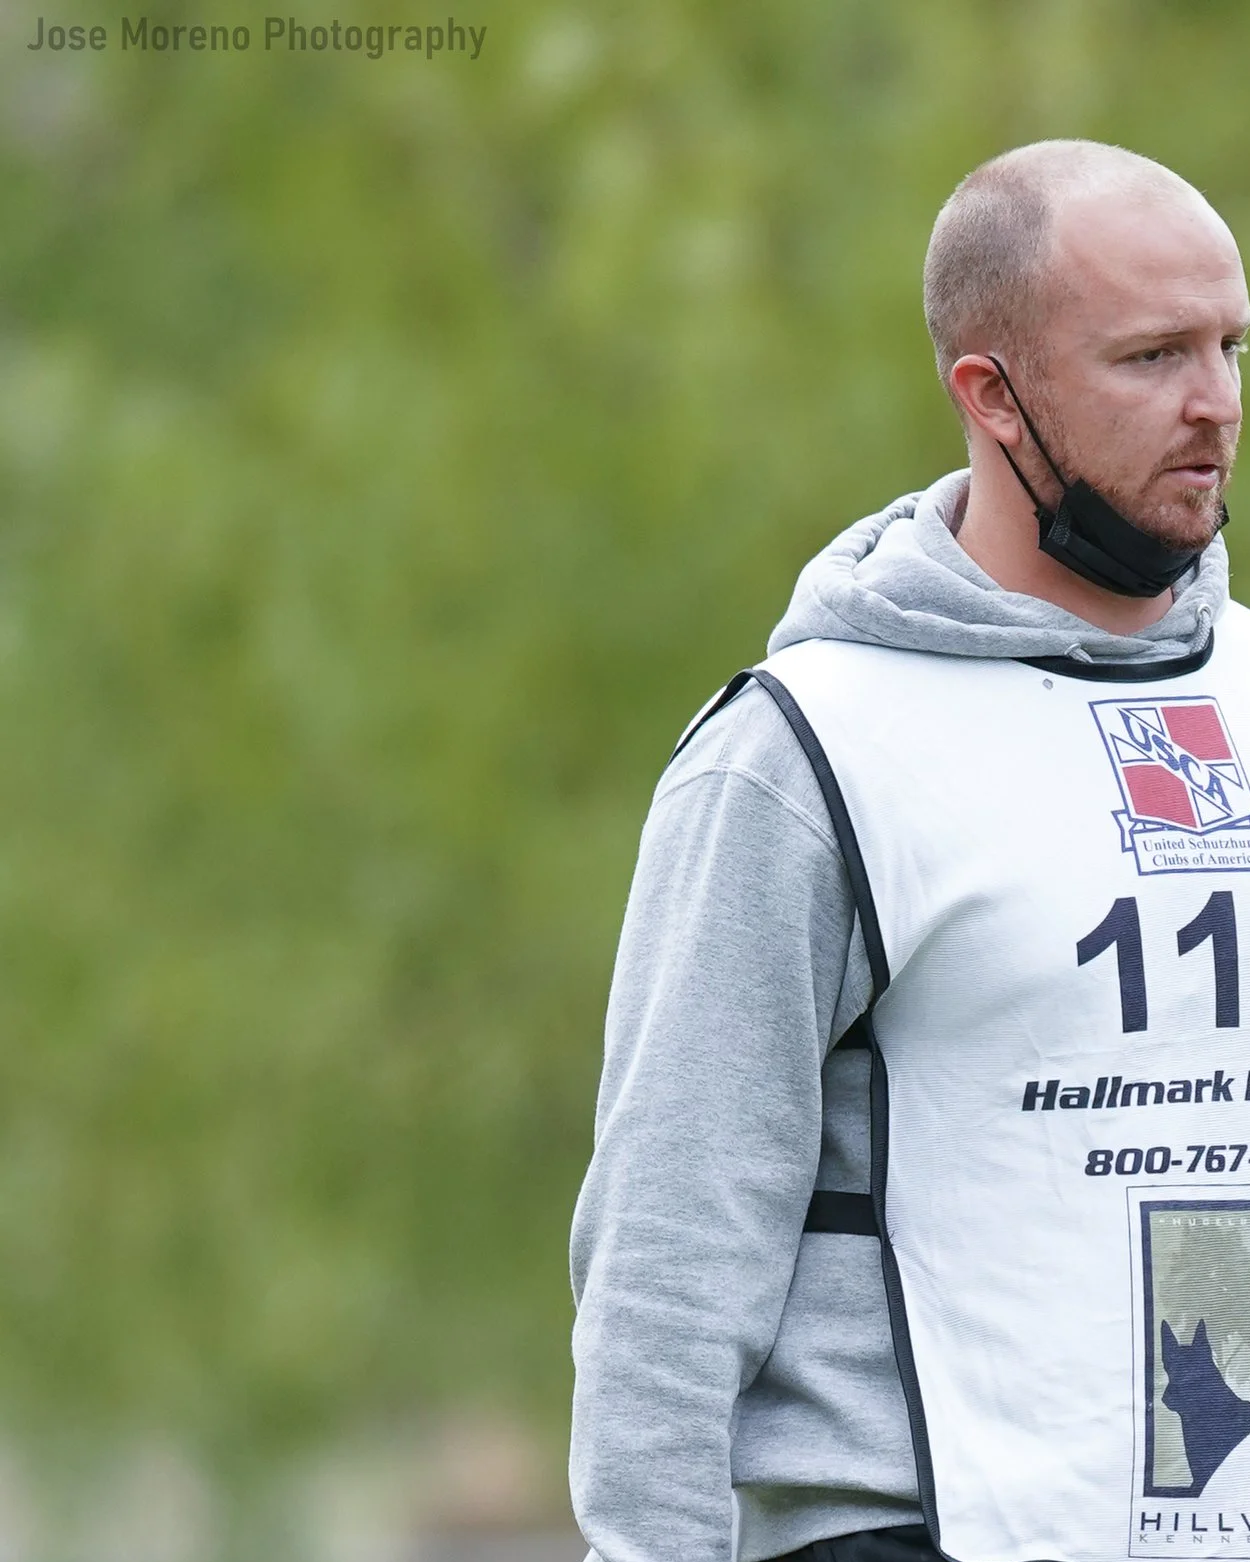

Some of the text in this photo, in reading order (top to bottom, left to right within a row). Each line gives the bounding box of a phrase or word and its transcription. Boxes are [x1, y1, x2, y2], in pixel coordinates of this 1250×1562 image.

[1117, 708, 1235, 814] USCA
[1142, 839, 1185, 852] United
[1152, 853, 1189, 867] Clubs
[1192, 852, 1206, 865] of
[1022, 1070, 1235, 1112] Hallmark
